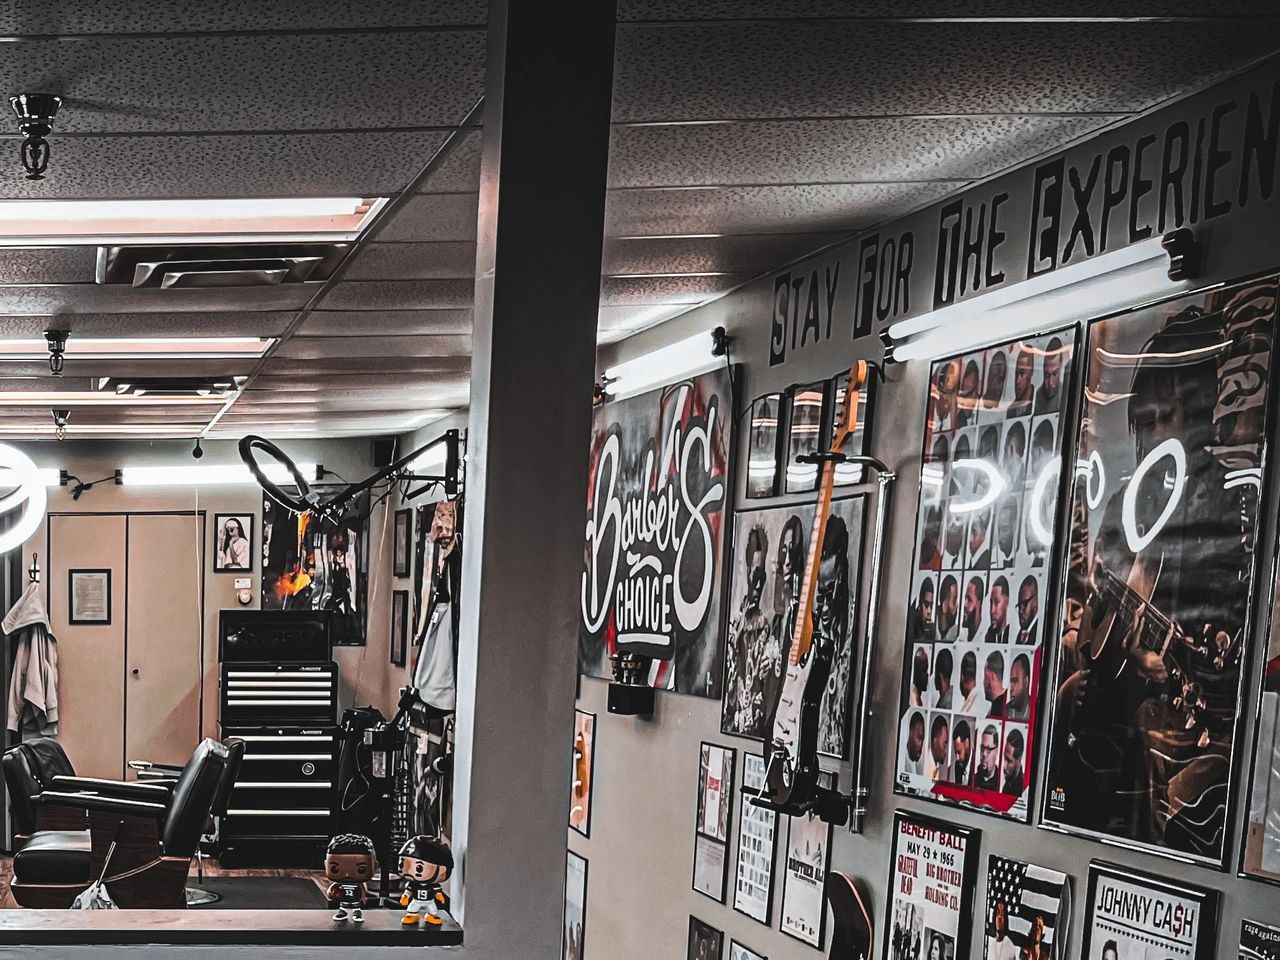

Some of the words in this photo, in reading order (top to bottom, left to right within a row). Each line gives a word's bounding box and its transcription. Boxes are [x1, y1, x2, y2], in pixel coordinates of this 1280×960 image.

[768, 260, 840, 368] STAY
[852, 230, 915, 340] FOR
[932, 190, 1009, 309] THE
[616, 574, 673, 633] CHOICE
[901, 822, 936, 843] BENEFIT
[939, 832, 964, 852] BALL
[907, 841, 921, 856] MAY
[922, 846, 931, 859] 29
[940, 851, 955, 867] 1966
[936, 865, 962, 888] BROTHER
[417, 889, 428, 900] 19
[925, 885, 949, 908] HOLDING
[1097, 885, 1153, 925] JOHNNY
[1153, 899, 1195, 938] CA$H
